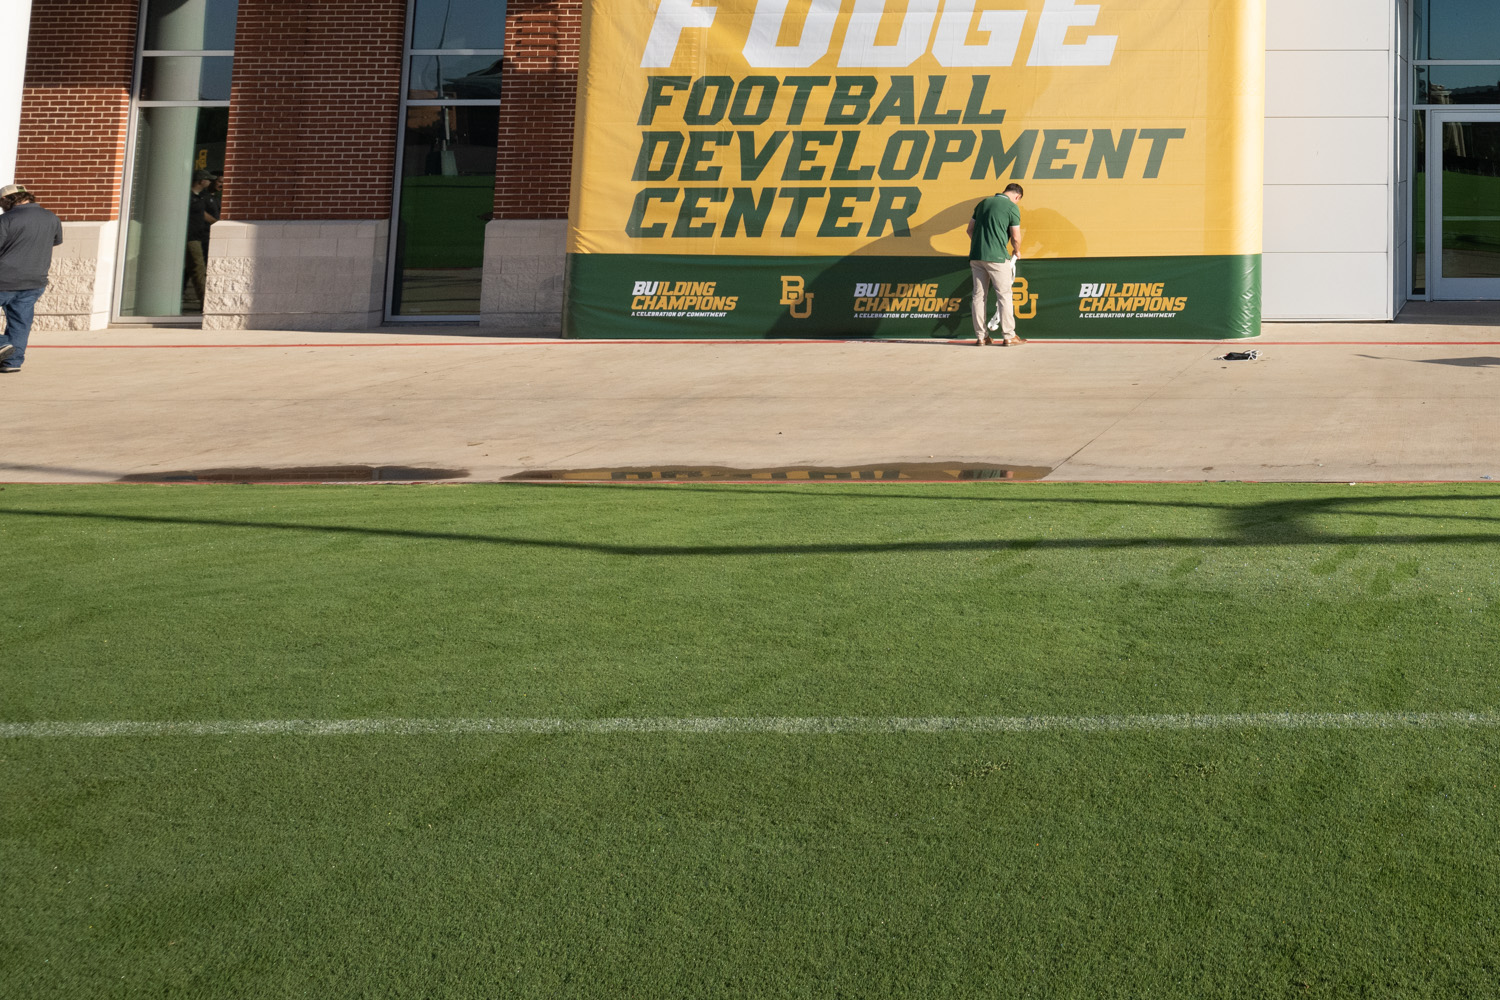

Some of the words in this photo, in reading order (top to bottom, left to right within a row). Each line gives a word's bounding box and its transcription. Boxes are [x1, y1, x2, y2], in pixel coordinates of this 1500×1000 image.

[637, 75, 1006, 126] FOOTBALL
[631, 129, 1186, 181] DEVELOPMENT
[625, 187, 922, 238] CENTER
[632, 281, 717, 296] BUILDING
[853, 283, 939, 298] BUILDING
[1078, 282, 1165, 298] BUILDING
[630, 295, 739, 311] CHAMPIONS
[779, 275, 815, 319] BU
[853, 297, 962, 312] CHAMPIONS
[1078, 297, 1188, 312] CHAMPIONS
